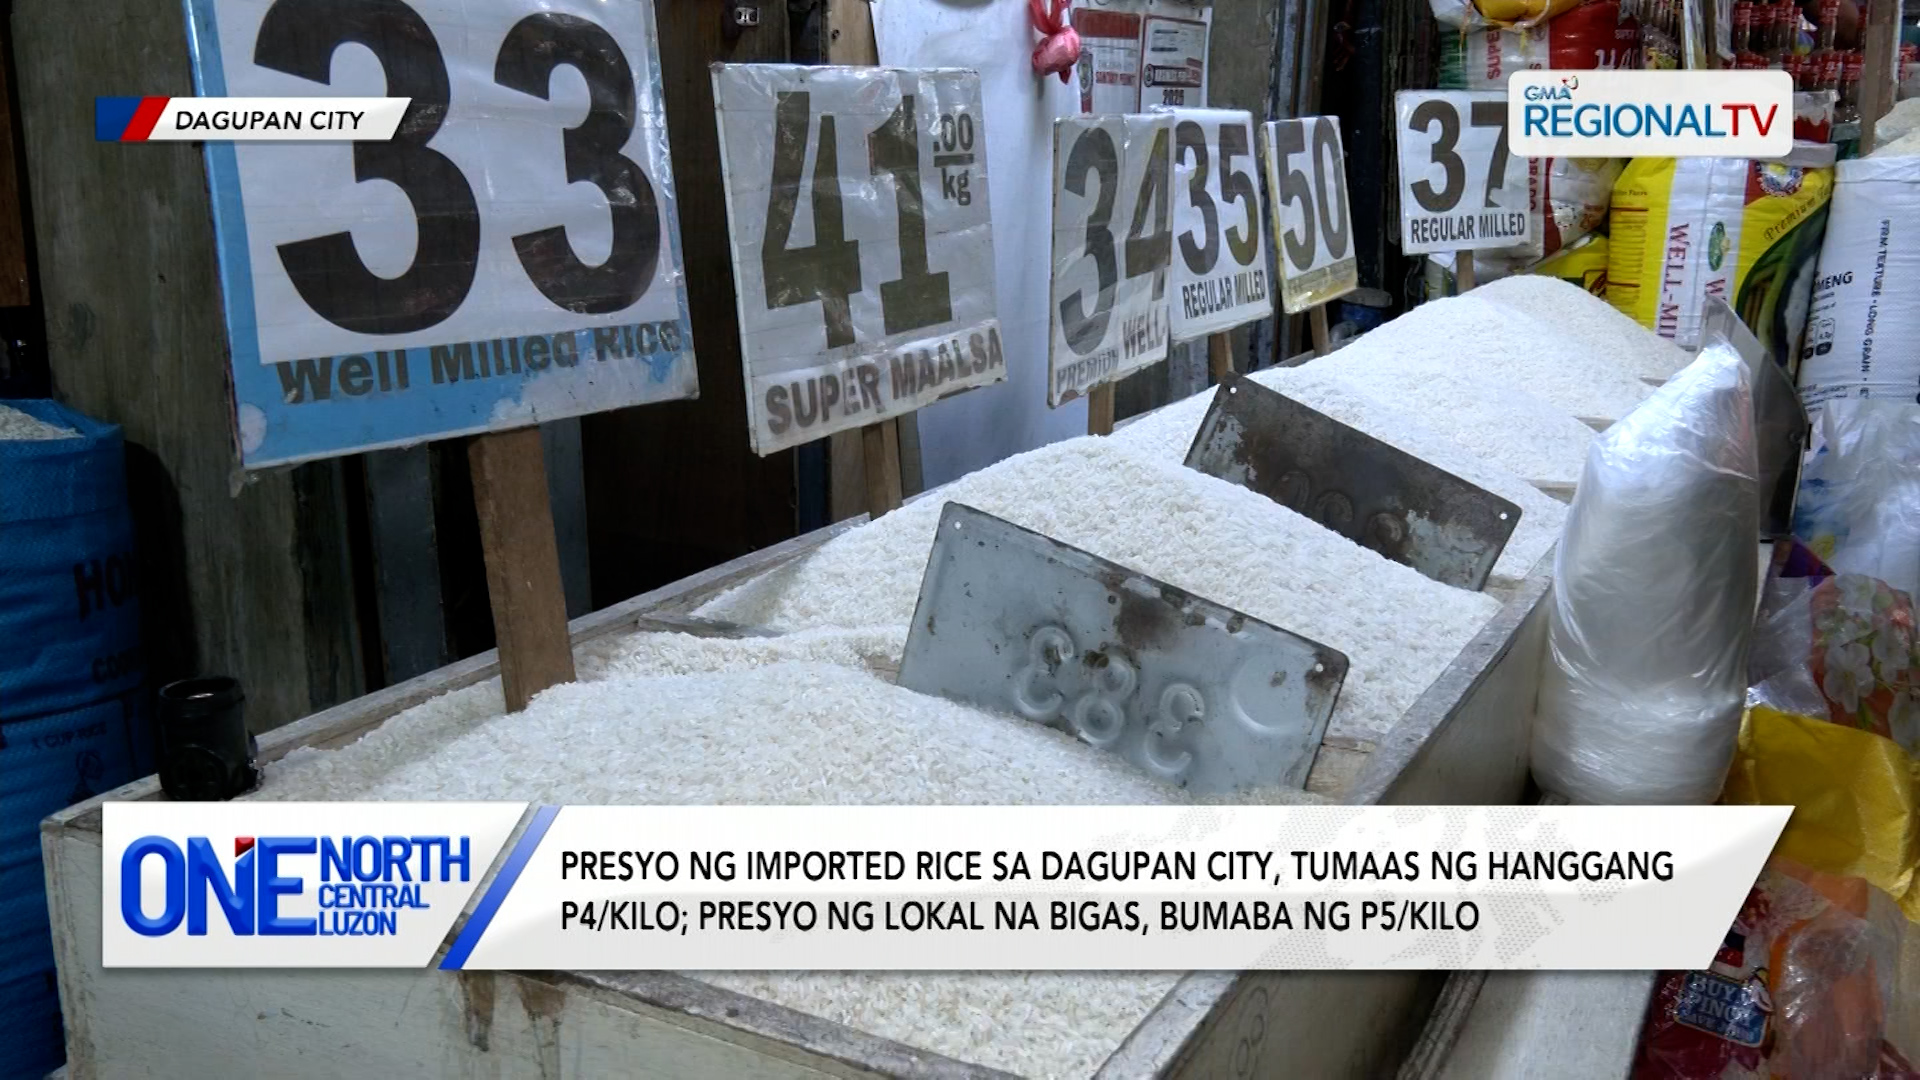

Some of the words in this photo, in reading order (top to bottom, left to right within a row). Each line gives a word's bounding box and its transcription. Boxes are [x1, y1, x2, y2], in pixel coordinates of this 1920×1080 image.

[1487, 30, 1500, 80] SUPE
[254, 0, 661, 336] 33
[942, 168, 972, 206] kg
[1175, 119, 1259, 276] 35
[1275, 117, 1348, 272] 50
[1409, 99, 1508, 213] 37
[762, 91, 953, 349] 41
[1063, 127, 1171, 356] 34
[1410, 215, 1475, 243] REGULAR
[1479, 213, 1526, 238] MILLED
[1182, 275, 1233, 320] REGULAR
[1234, 268, 1267, 307] MILLED
[277, 349, 410, 404] Well
[765, 364, 886, 436] SUPER
[888, 325, 1004, 402] MAALSA
[1689, 974, 1738, 1001] BUY
